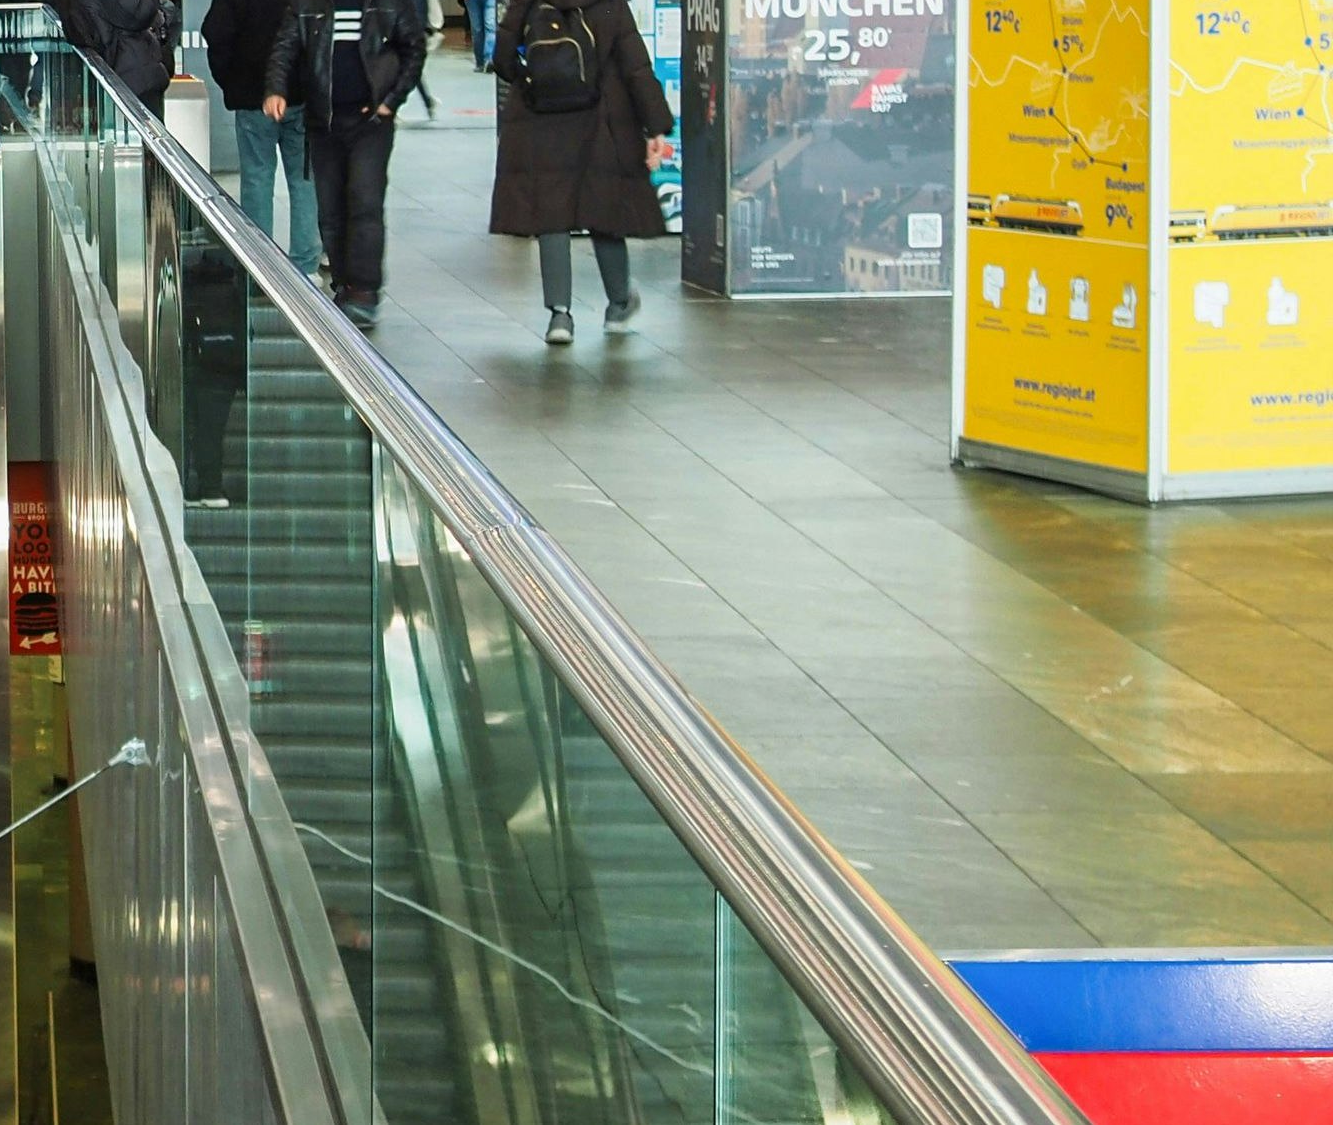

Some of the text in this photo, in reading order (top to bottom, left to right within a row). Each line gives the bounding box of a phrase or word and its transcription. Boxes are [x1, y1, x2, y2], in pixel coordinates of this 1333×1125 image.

[1023, 105, 1046, 117] Wien
[1255, 108, 1292, 120] Wien
[1105, 177, 1145, 193] Budapest
[1014, 376, 1096, 403] www.regiojet.at
[13, 581, 23, 593] A
